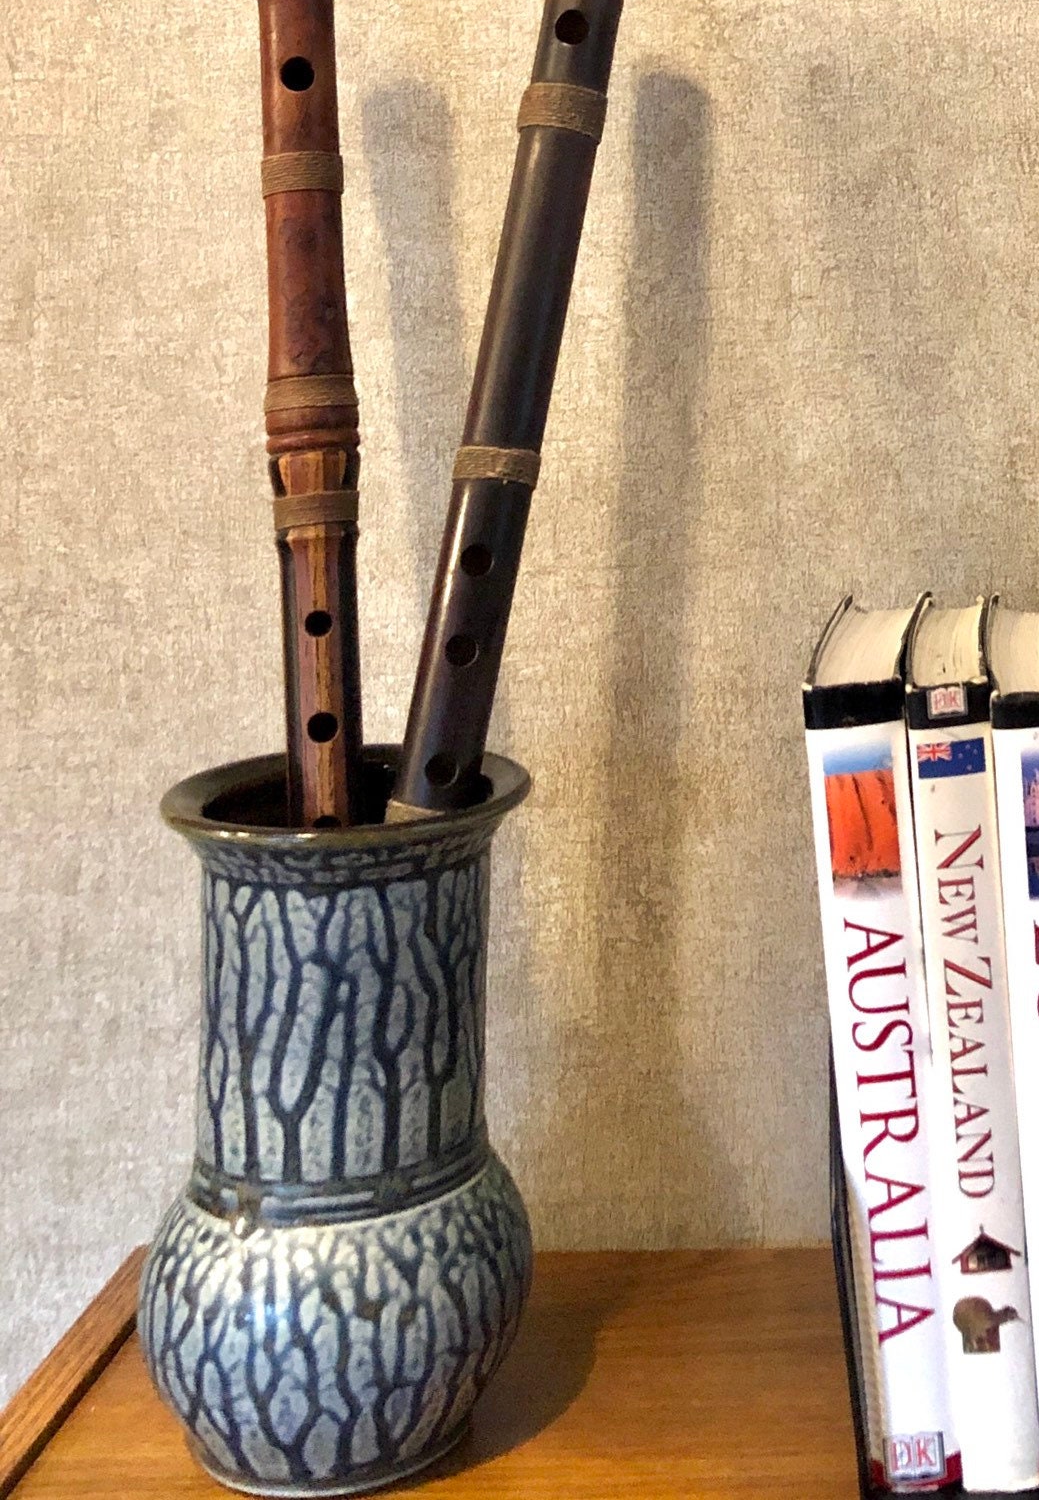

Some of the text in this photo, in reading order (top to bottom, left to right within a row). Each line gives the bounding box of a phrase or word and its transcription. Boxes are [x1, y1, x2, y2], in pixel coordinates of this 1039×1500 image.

[932, 689, 960, 710] DK
[934, 823, 996, 1199] NEW ZEALAND
[843, 917, 935, 1344] AUSTRALIA
[890, 1436, 937, 1472] DK
